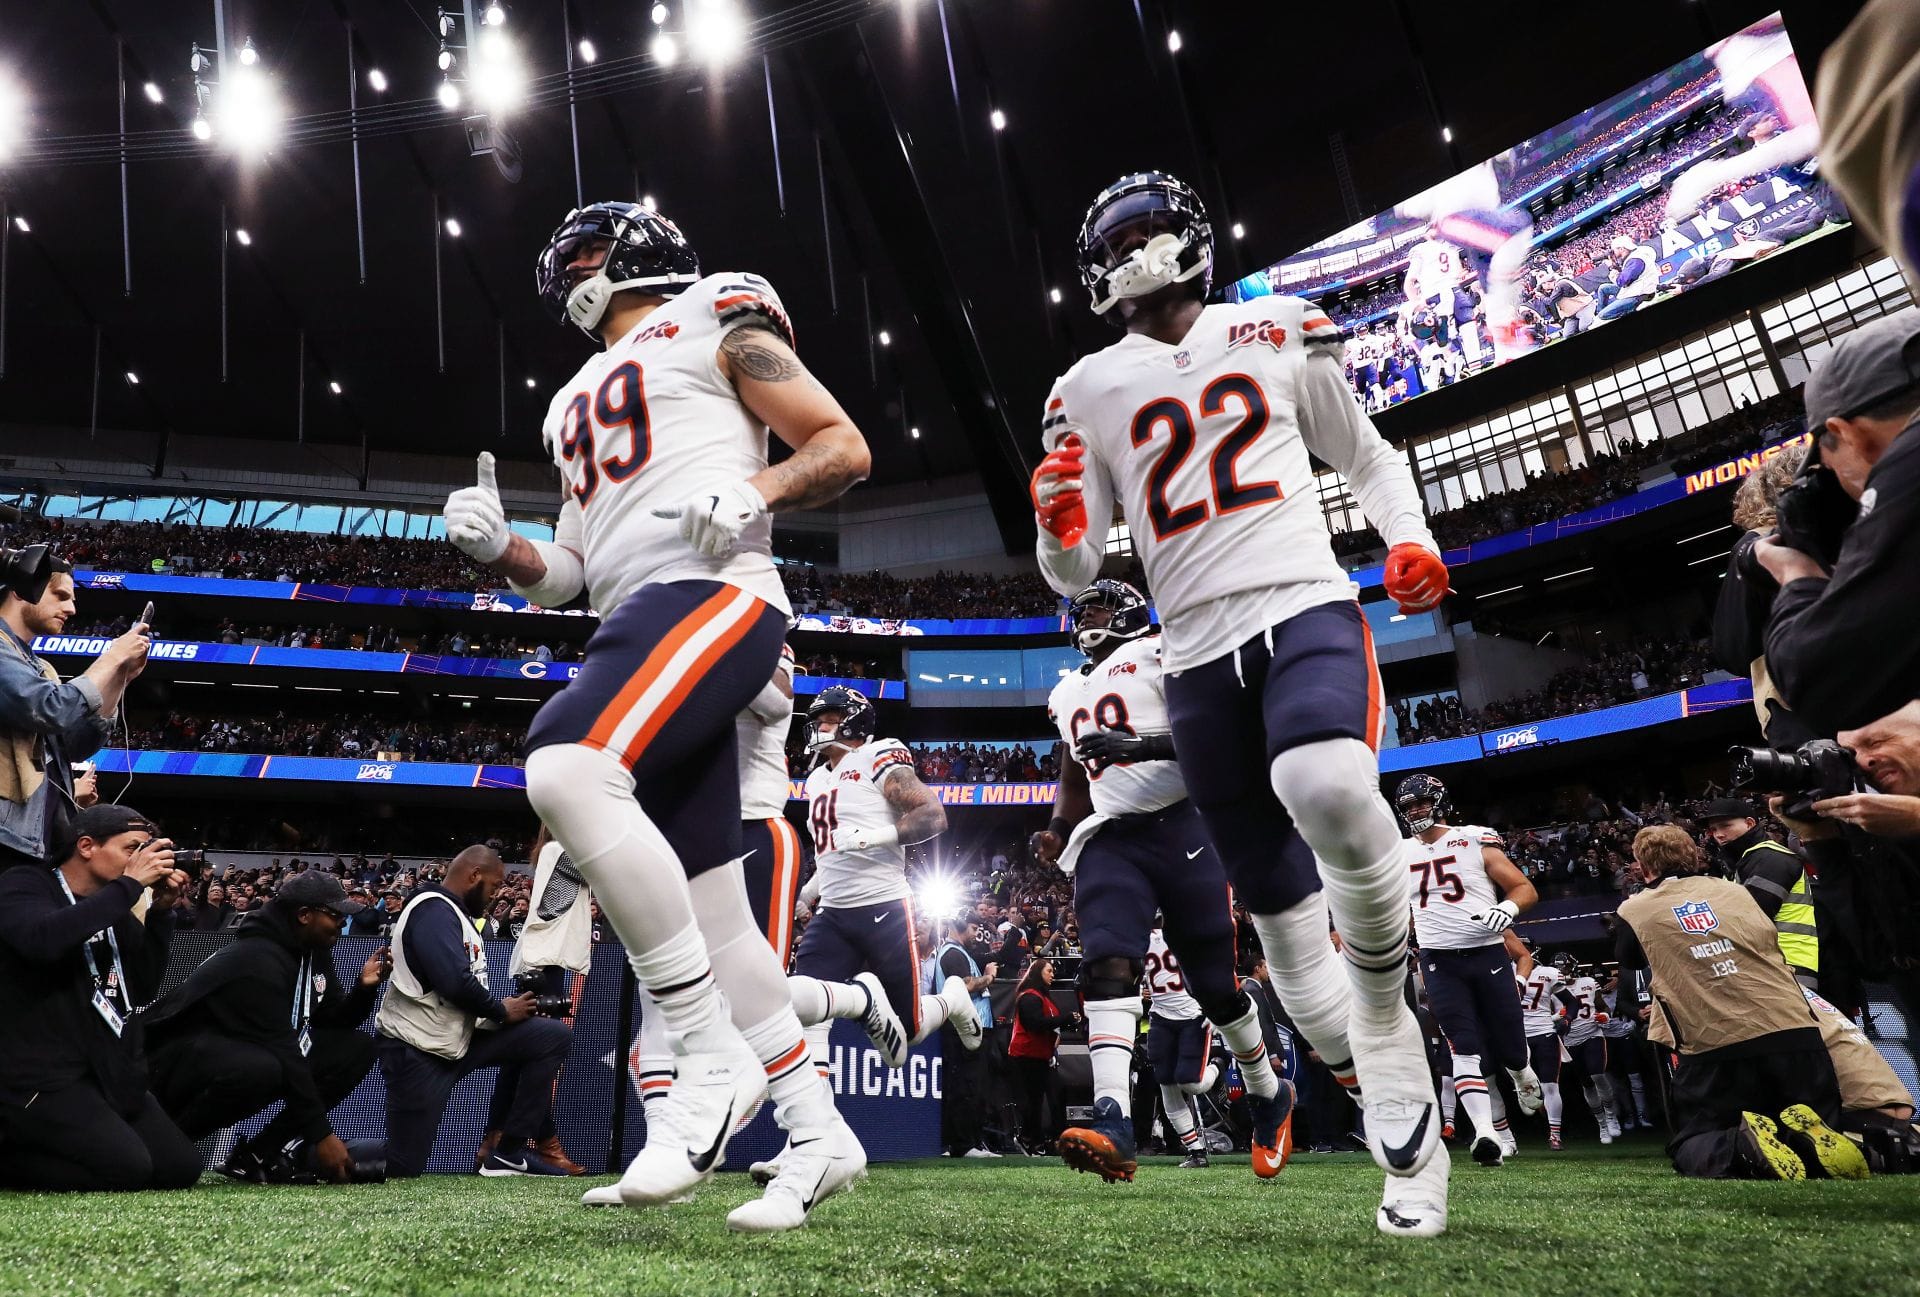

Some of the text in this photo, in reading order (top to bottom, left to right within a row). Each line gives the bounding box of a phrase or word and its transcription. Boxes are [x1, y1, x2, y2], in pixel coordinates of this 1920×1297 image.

[1661, 176, 1802, 260] AKLA
[560, 360, 653, 512] 99
[1130, 372, 1286, 544] 22
[147, 642, 199, 660] MES
[811, 788, 839, 855] 81
[936, 785, 1057, 804] THE MIDW
[1409, 855, 1466, 909] 75
[1682, 911, 1715, 933] NFL
[1690, 938, 1736, 960] MEDIA
[1144, 949, 1184, 994] 29
[829, 1045, 943, 1100] HICAG
